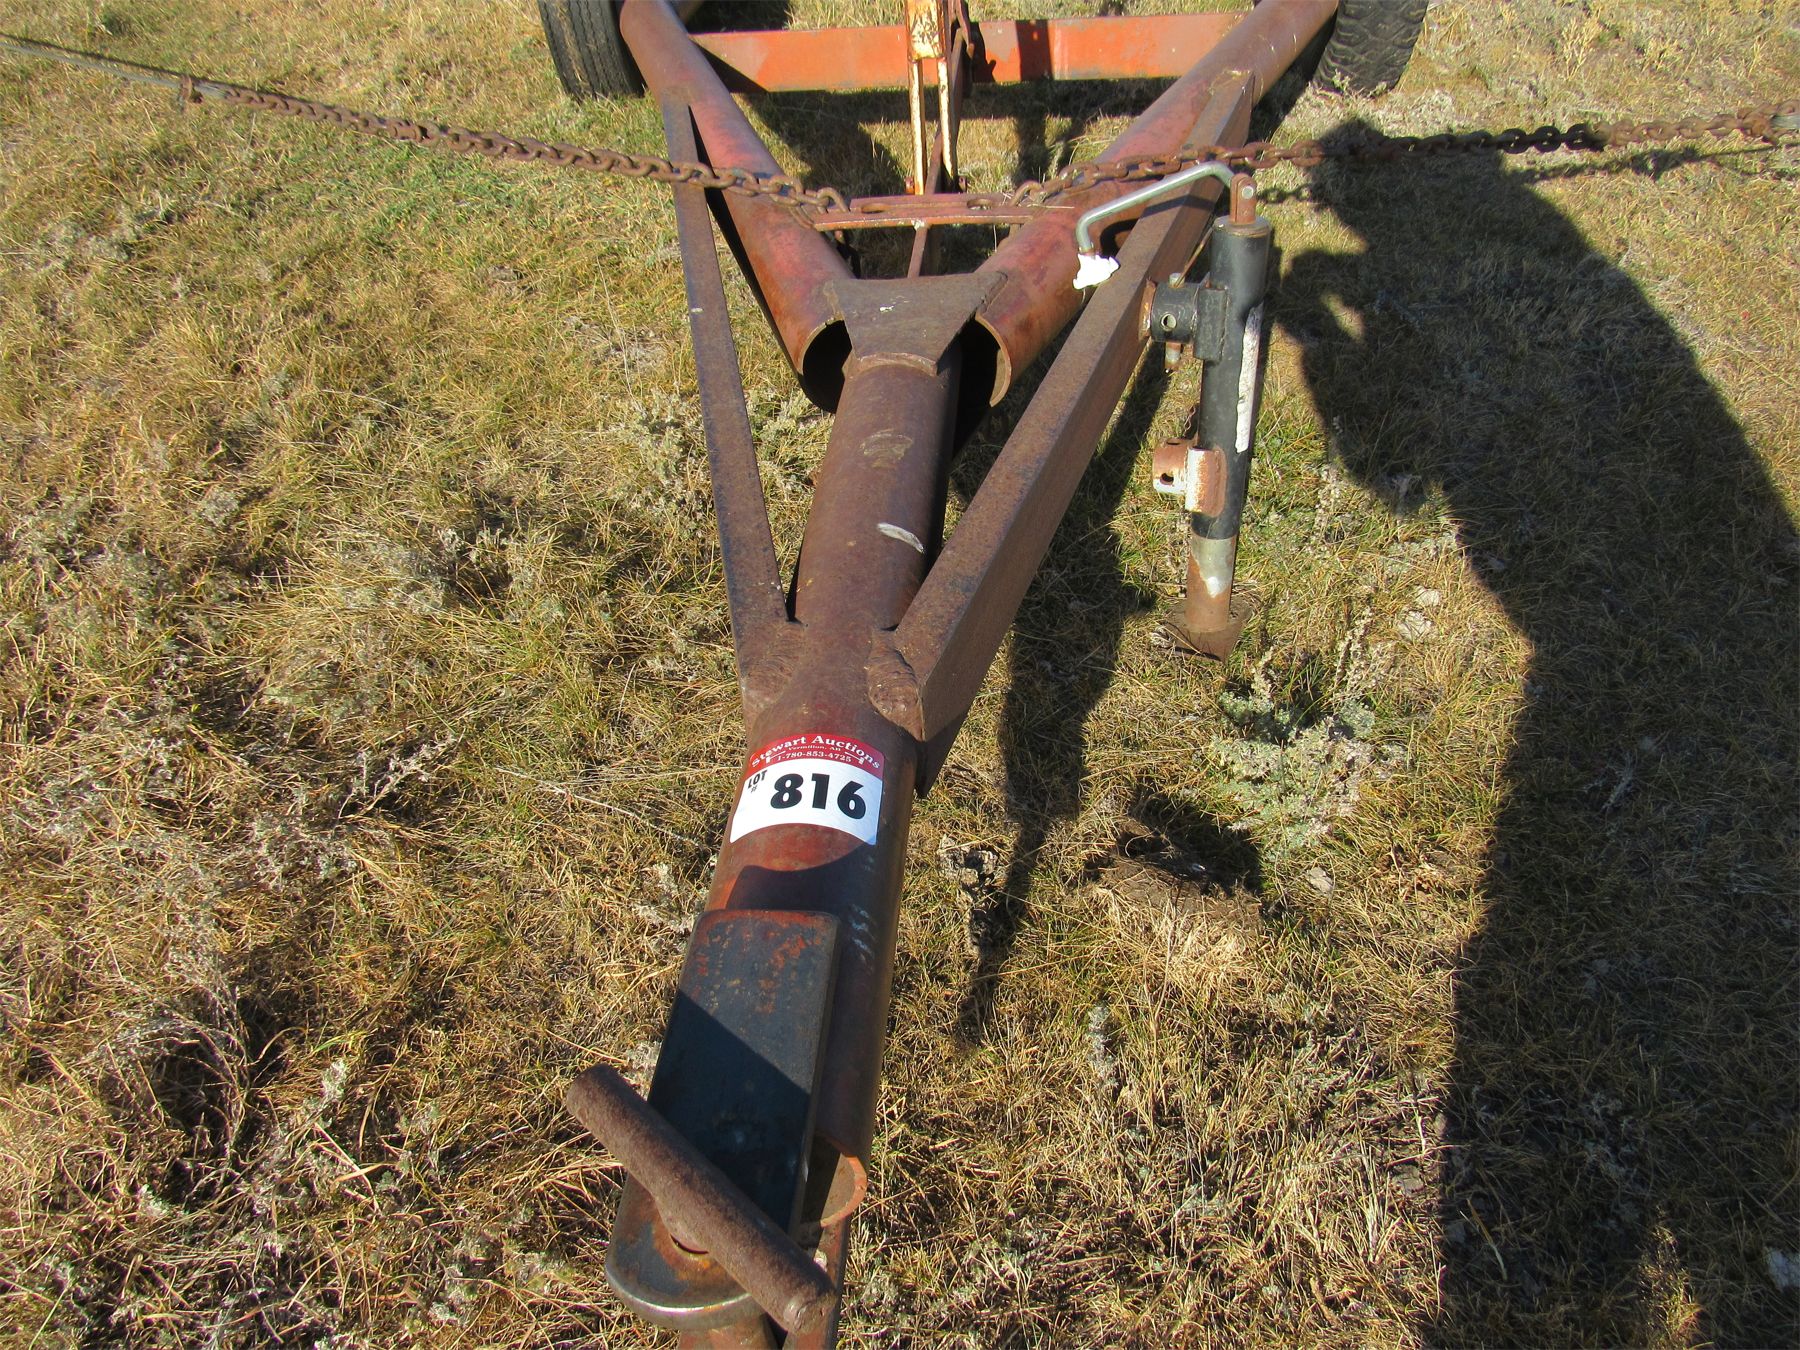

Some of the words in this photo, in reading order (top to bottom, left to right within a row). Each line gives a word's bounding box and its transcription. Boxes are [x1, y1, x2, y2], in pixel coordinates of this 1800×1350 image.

[752, 736, 806, 767] Stewart
[812, 735, 880, 769] Auctions
[777, 750, 852, 763] 1-780-853-4725
[748, 769, 768, 789] LOT
[770, 773, 867, 820] 816
